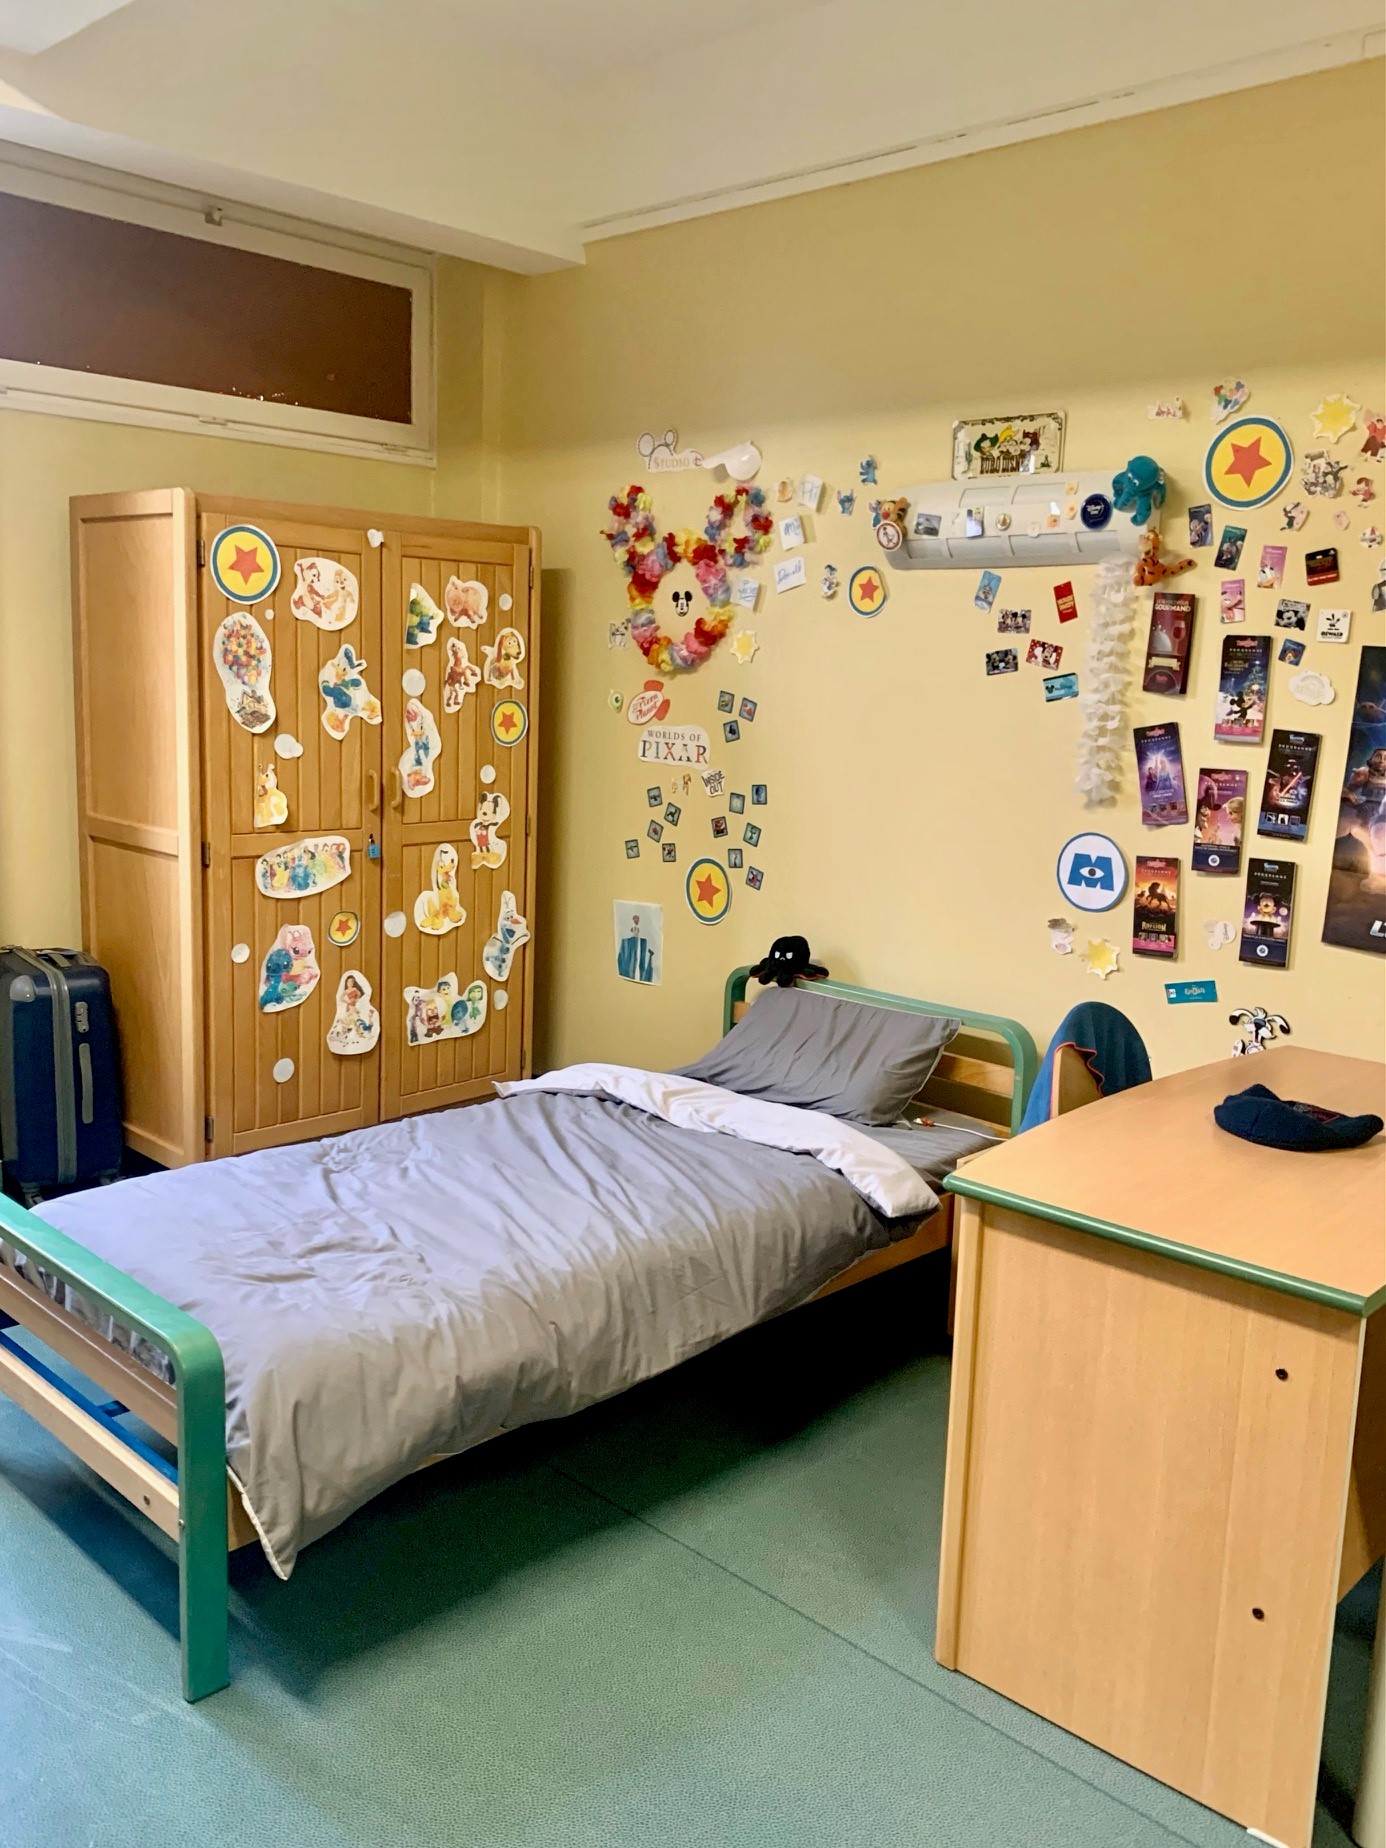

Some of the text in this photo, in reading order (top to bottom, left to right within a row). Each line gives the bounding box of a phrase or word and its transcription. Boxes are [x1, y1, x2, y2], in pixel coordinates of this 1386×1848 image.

[1155, 604, 1191, 612] GOURMAND
[647, 730, 702, 742] WORLDS OF
[640, 740, 708, 764] PIXAR
[701, 770, 725, 788] INSIDE
[709, 781, 723, 795] OUT
